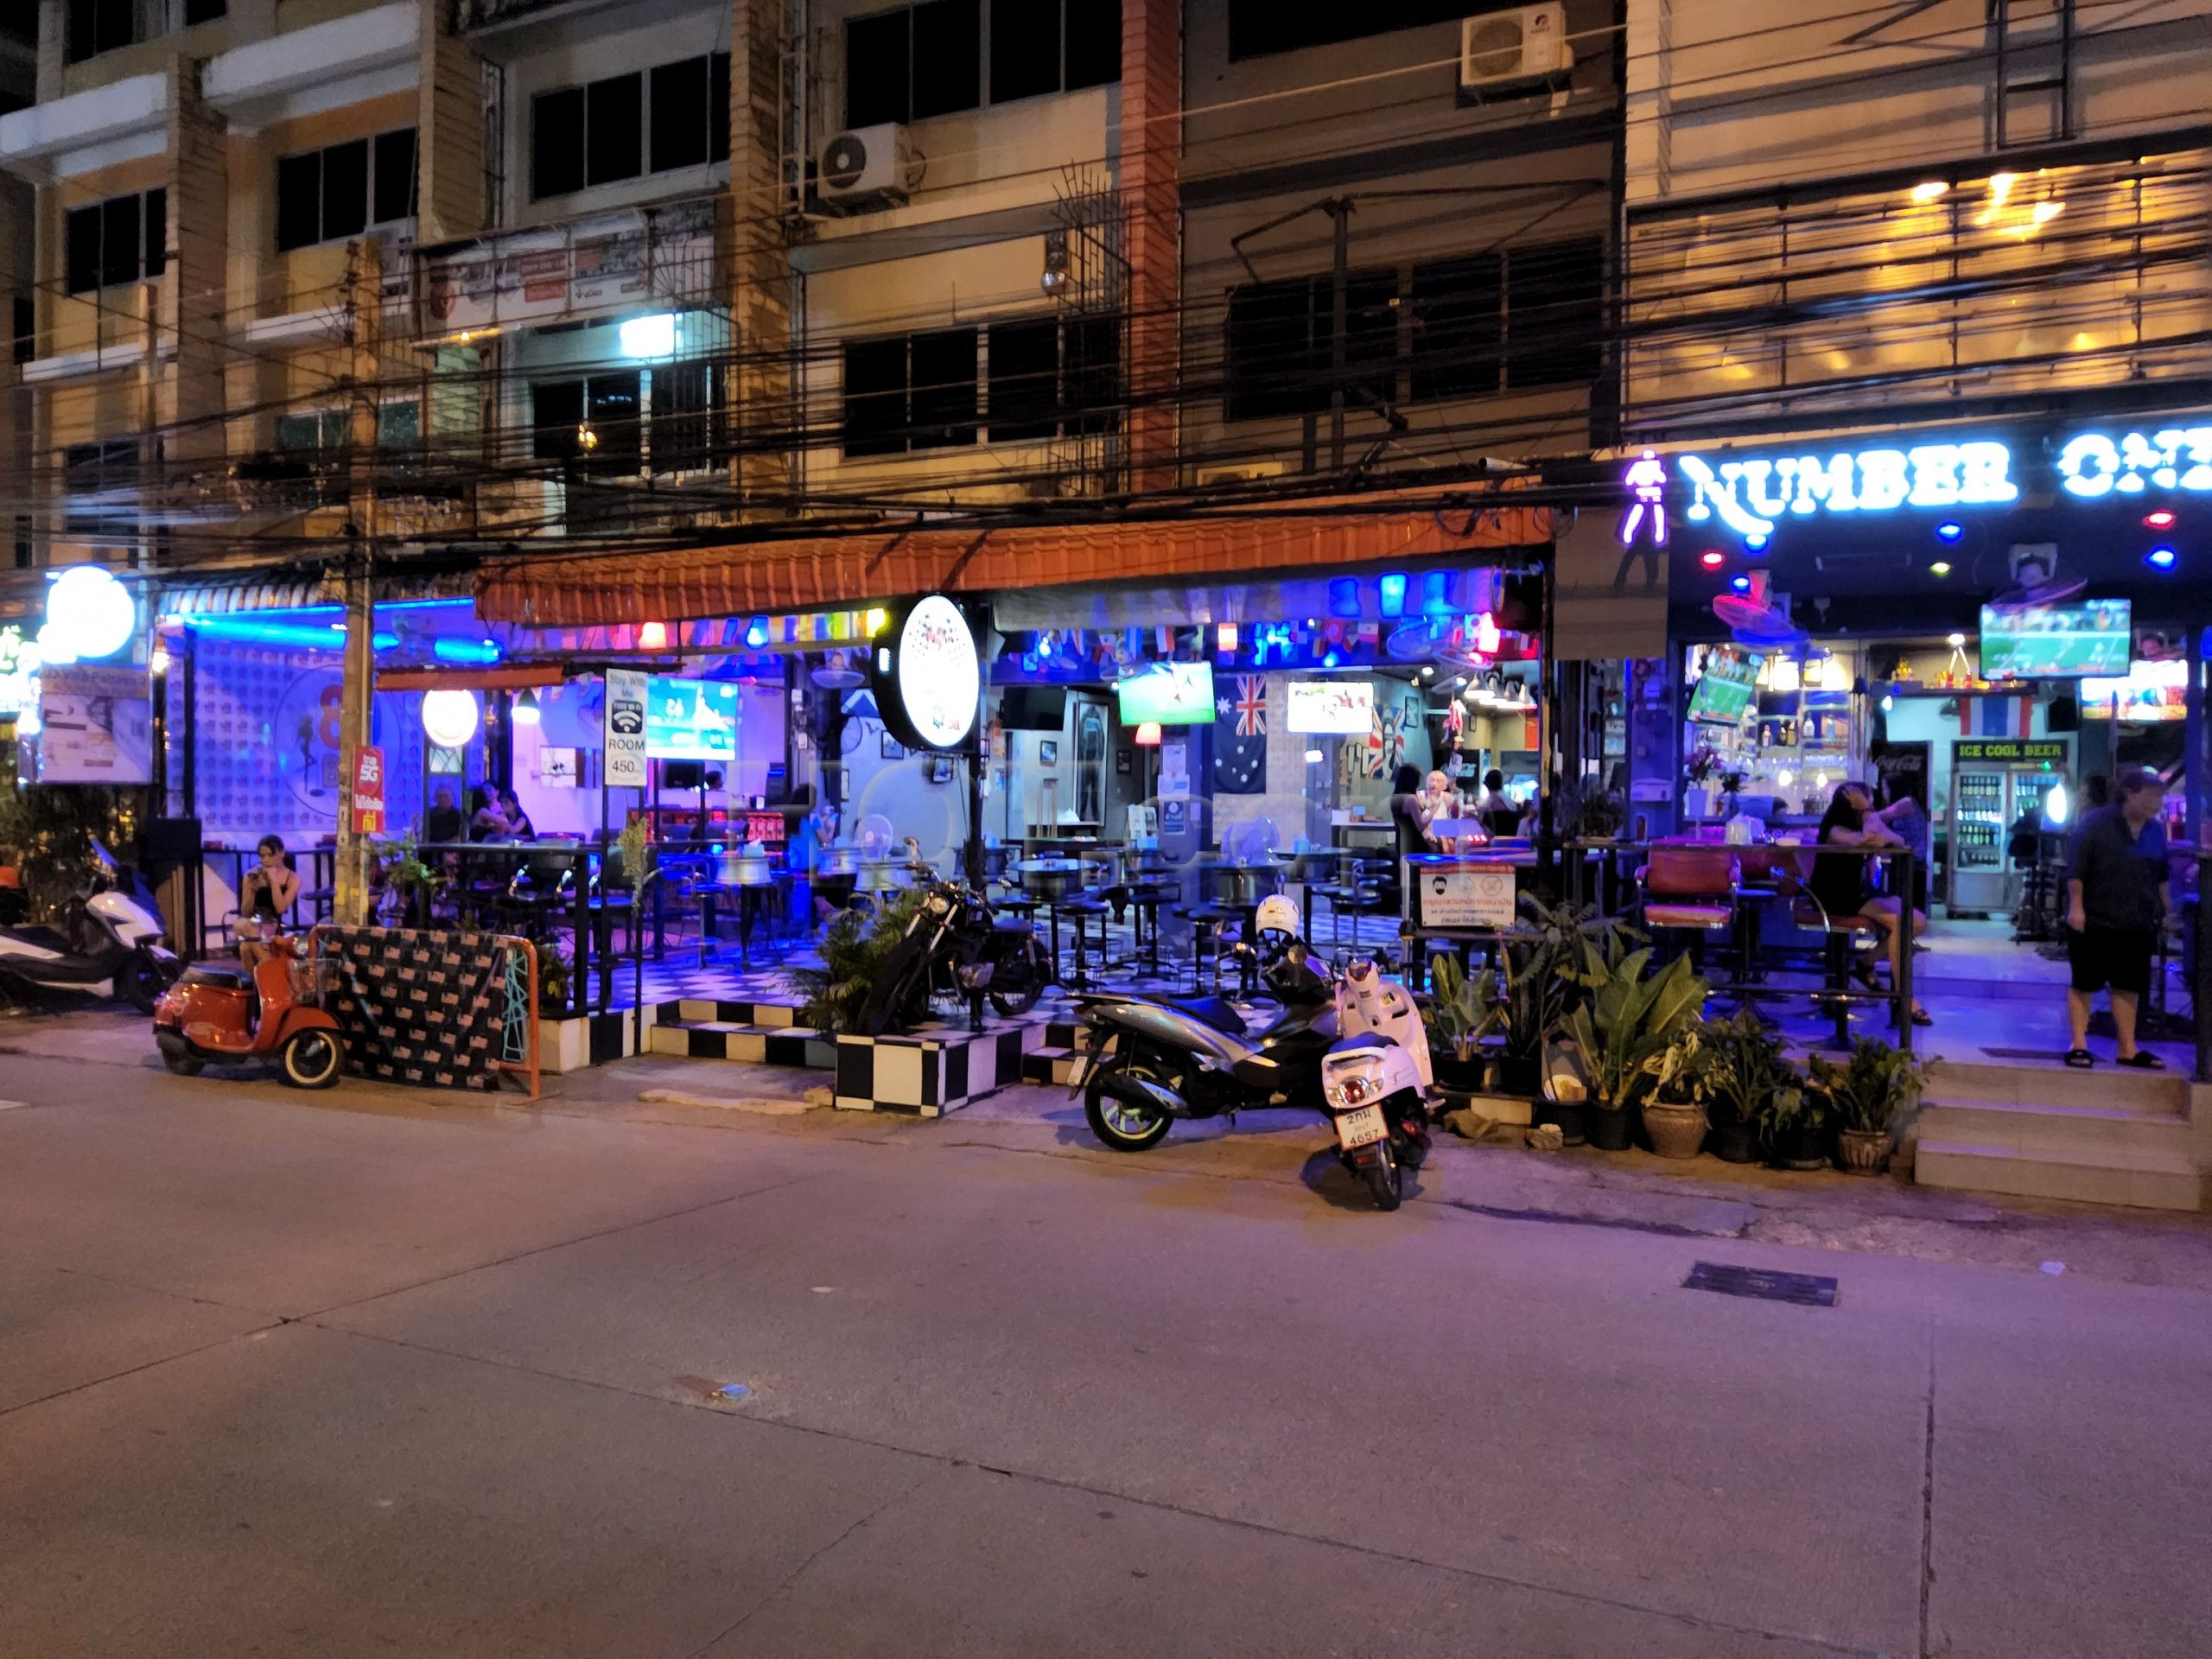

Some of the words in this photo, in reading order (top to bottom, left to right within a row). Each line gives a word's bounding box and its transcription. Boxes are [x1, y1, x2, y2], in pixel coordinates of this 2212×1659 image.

[1679, 442, 2018, 535] NUMBER
[2058, 426, 2212, 497] ONE
[608, 739, 645, 752] ROOM
[1959, 744, 1981, 757] ICE
[1985, 744, 2019, 757] COOL
[359, 764, 378, 782] 5G
[612, 760, 635, 774] 450
[1350, 1128, 1378, 1146] 4657
